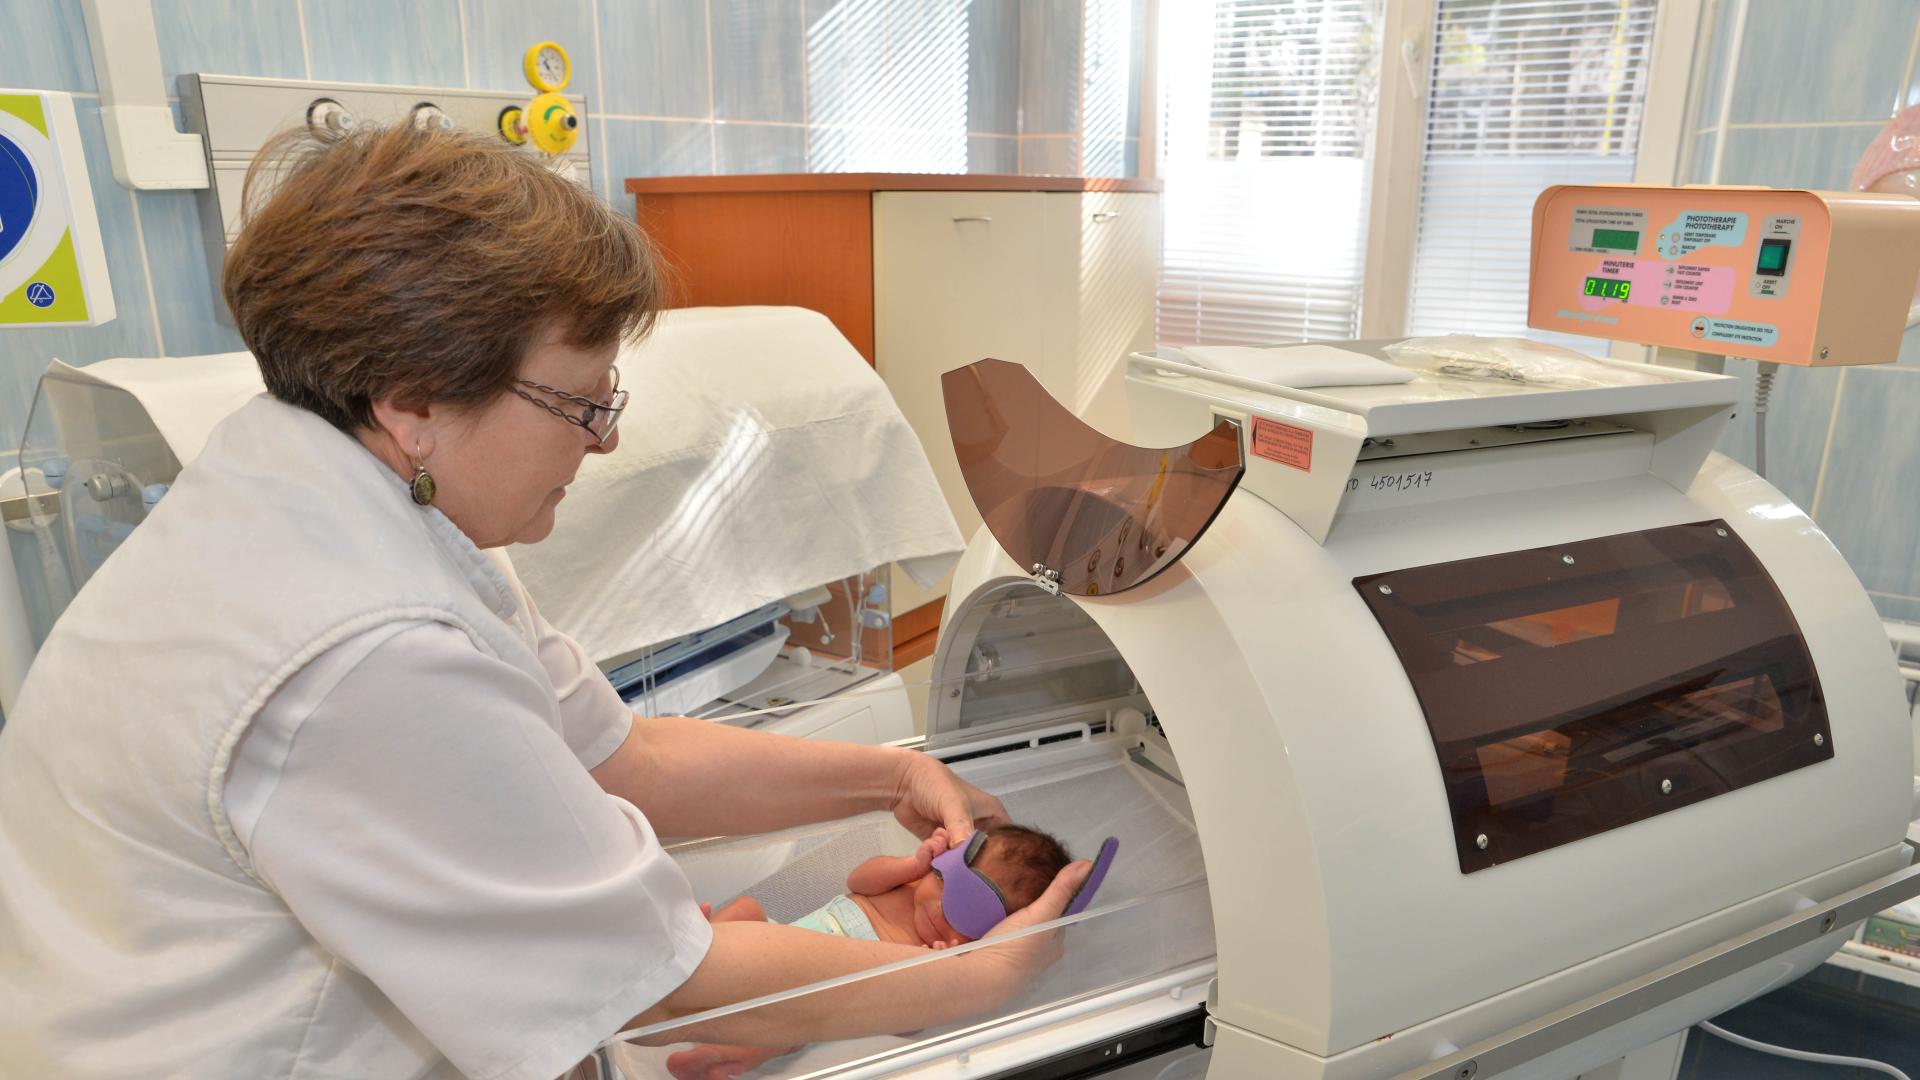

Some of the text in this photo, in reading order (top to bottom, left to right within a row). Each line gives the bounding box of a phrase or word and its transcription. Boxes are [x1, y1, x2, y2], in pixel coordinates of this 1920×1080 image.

[1686, 216, 1736, 224] PHOTOTHERAPIE
[1685, 223, 1734, 231] PHOTOTHERAPY
[1603, 260, 1635, 269] MINUTERIE
[1371, 472, 1432, 491] 4501517
